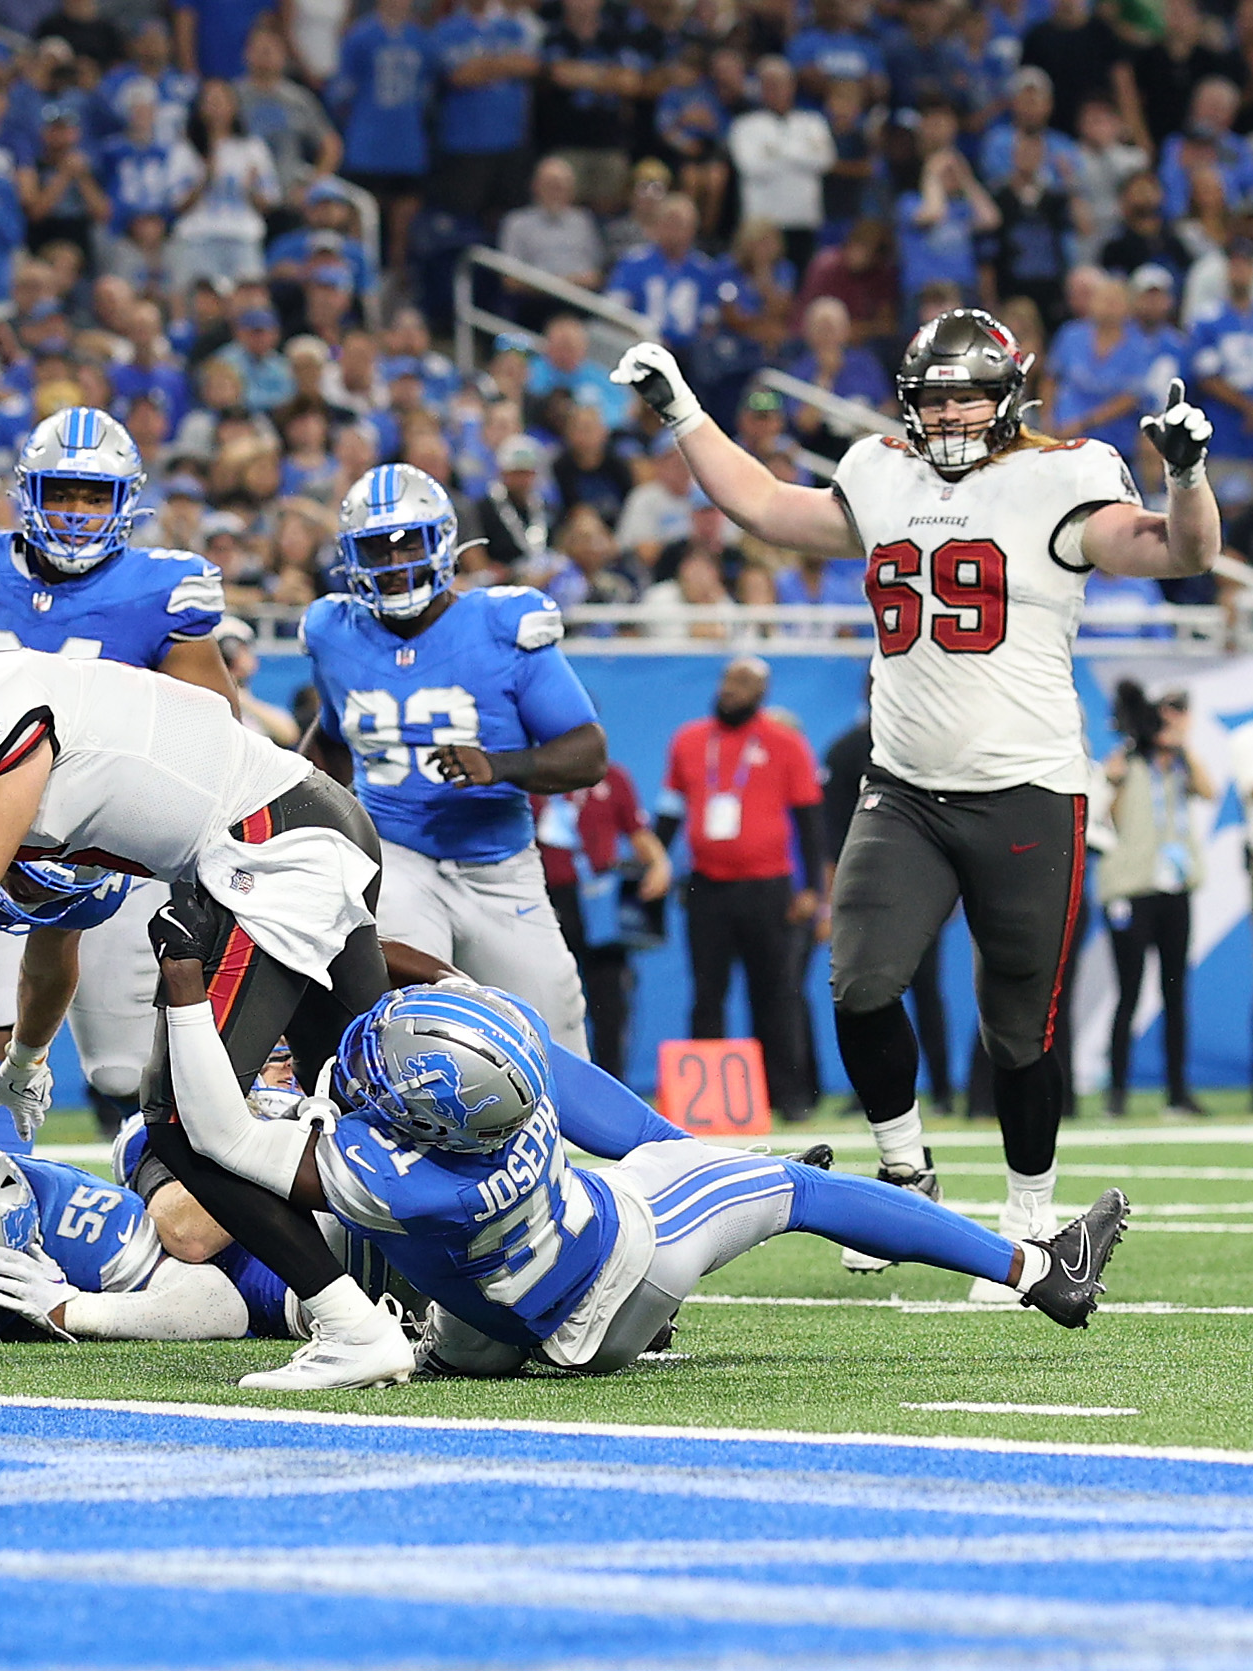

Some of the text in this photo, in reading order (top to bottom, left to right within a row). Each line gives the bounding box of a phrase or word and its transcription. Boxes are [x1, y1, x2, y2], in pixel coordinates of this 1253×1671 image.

[907, 515, 970, 528] BUCCANEERS
[865, 538, 1008, 659] 69
[343, 685, 482, 787] 93
[678, 1052, 755, 1127] 20
[474, 1094, 559, 1223] JOSEPH
[56, 1185, 124, 1245] 55
[467, 1127, 595, 1308] 31
